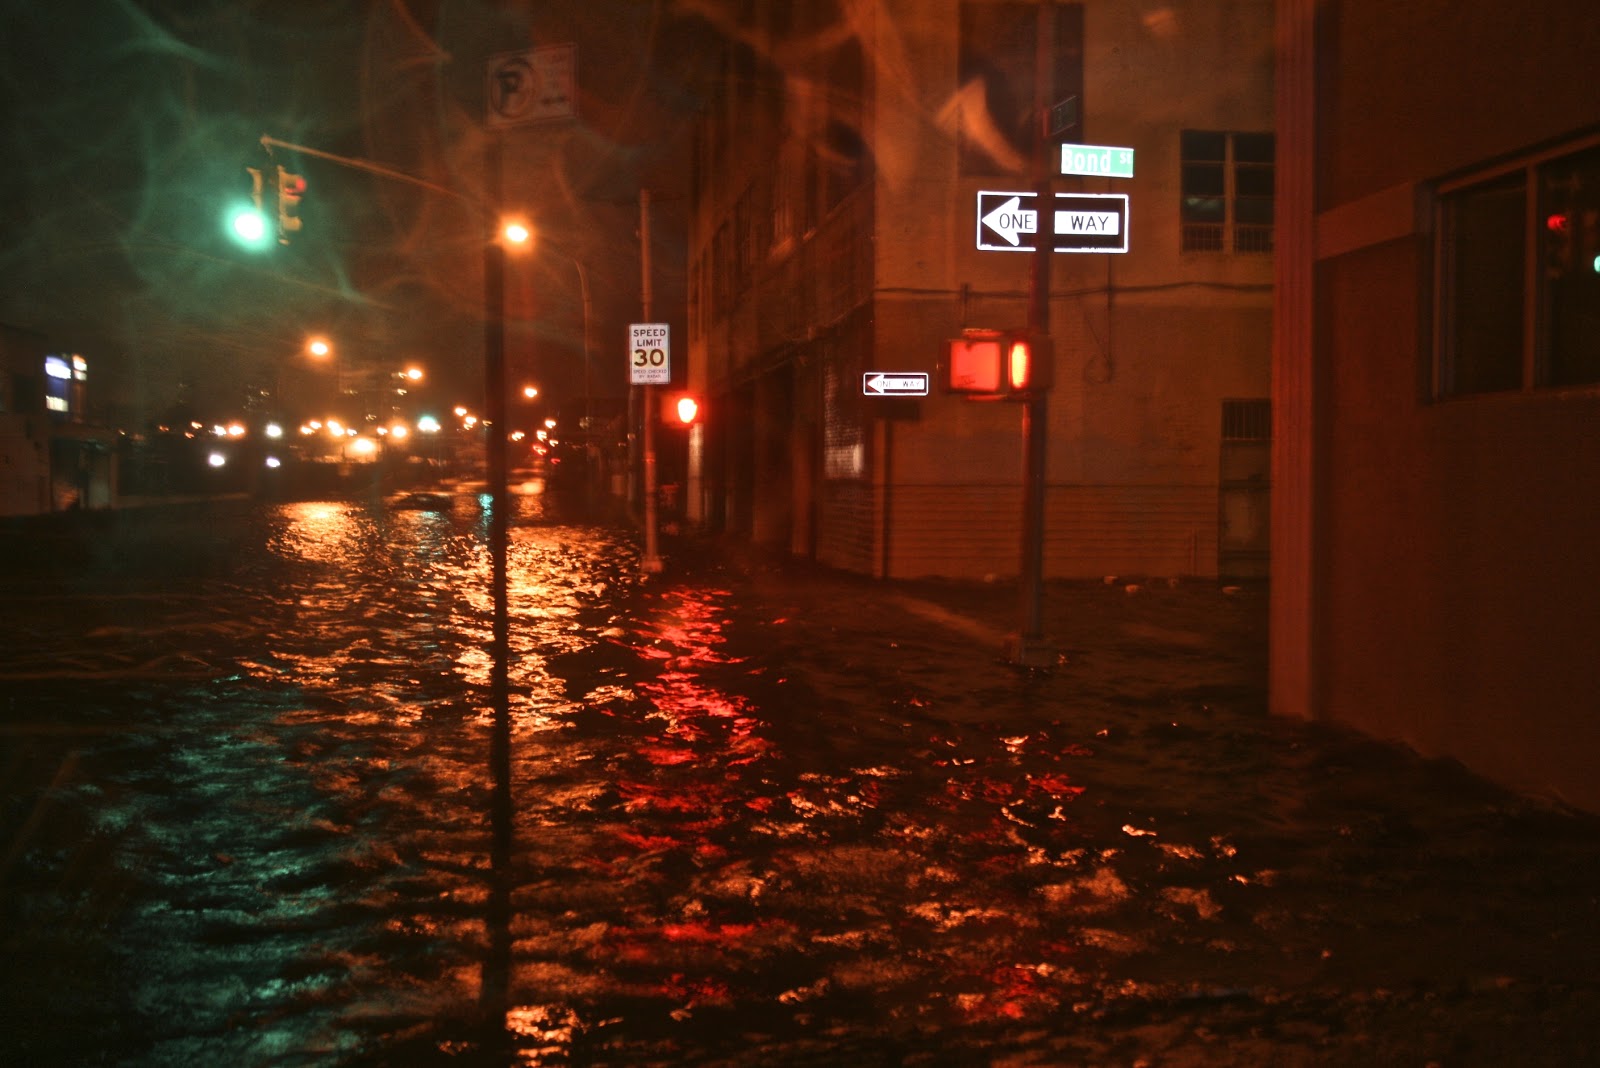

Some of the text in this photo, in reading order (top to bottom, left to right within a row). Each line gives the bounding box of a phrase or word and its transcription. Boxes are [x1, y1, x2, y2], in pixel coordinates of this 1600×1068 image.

[1062, 149, 1112, 173] Bond
[999, 213, 1109, 231] ONE WAY
[633, 329, 666, 337] SPEED
[636, 339, 662, 347] LIMIT
[634, 349, 664, 367] 30
